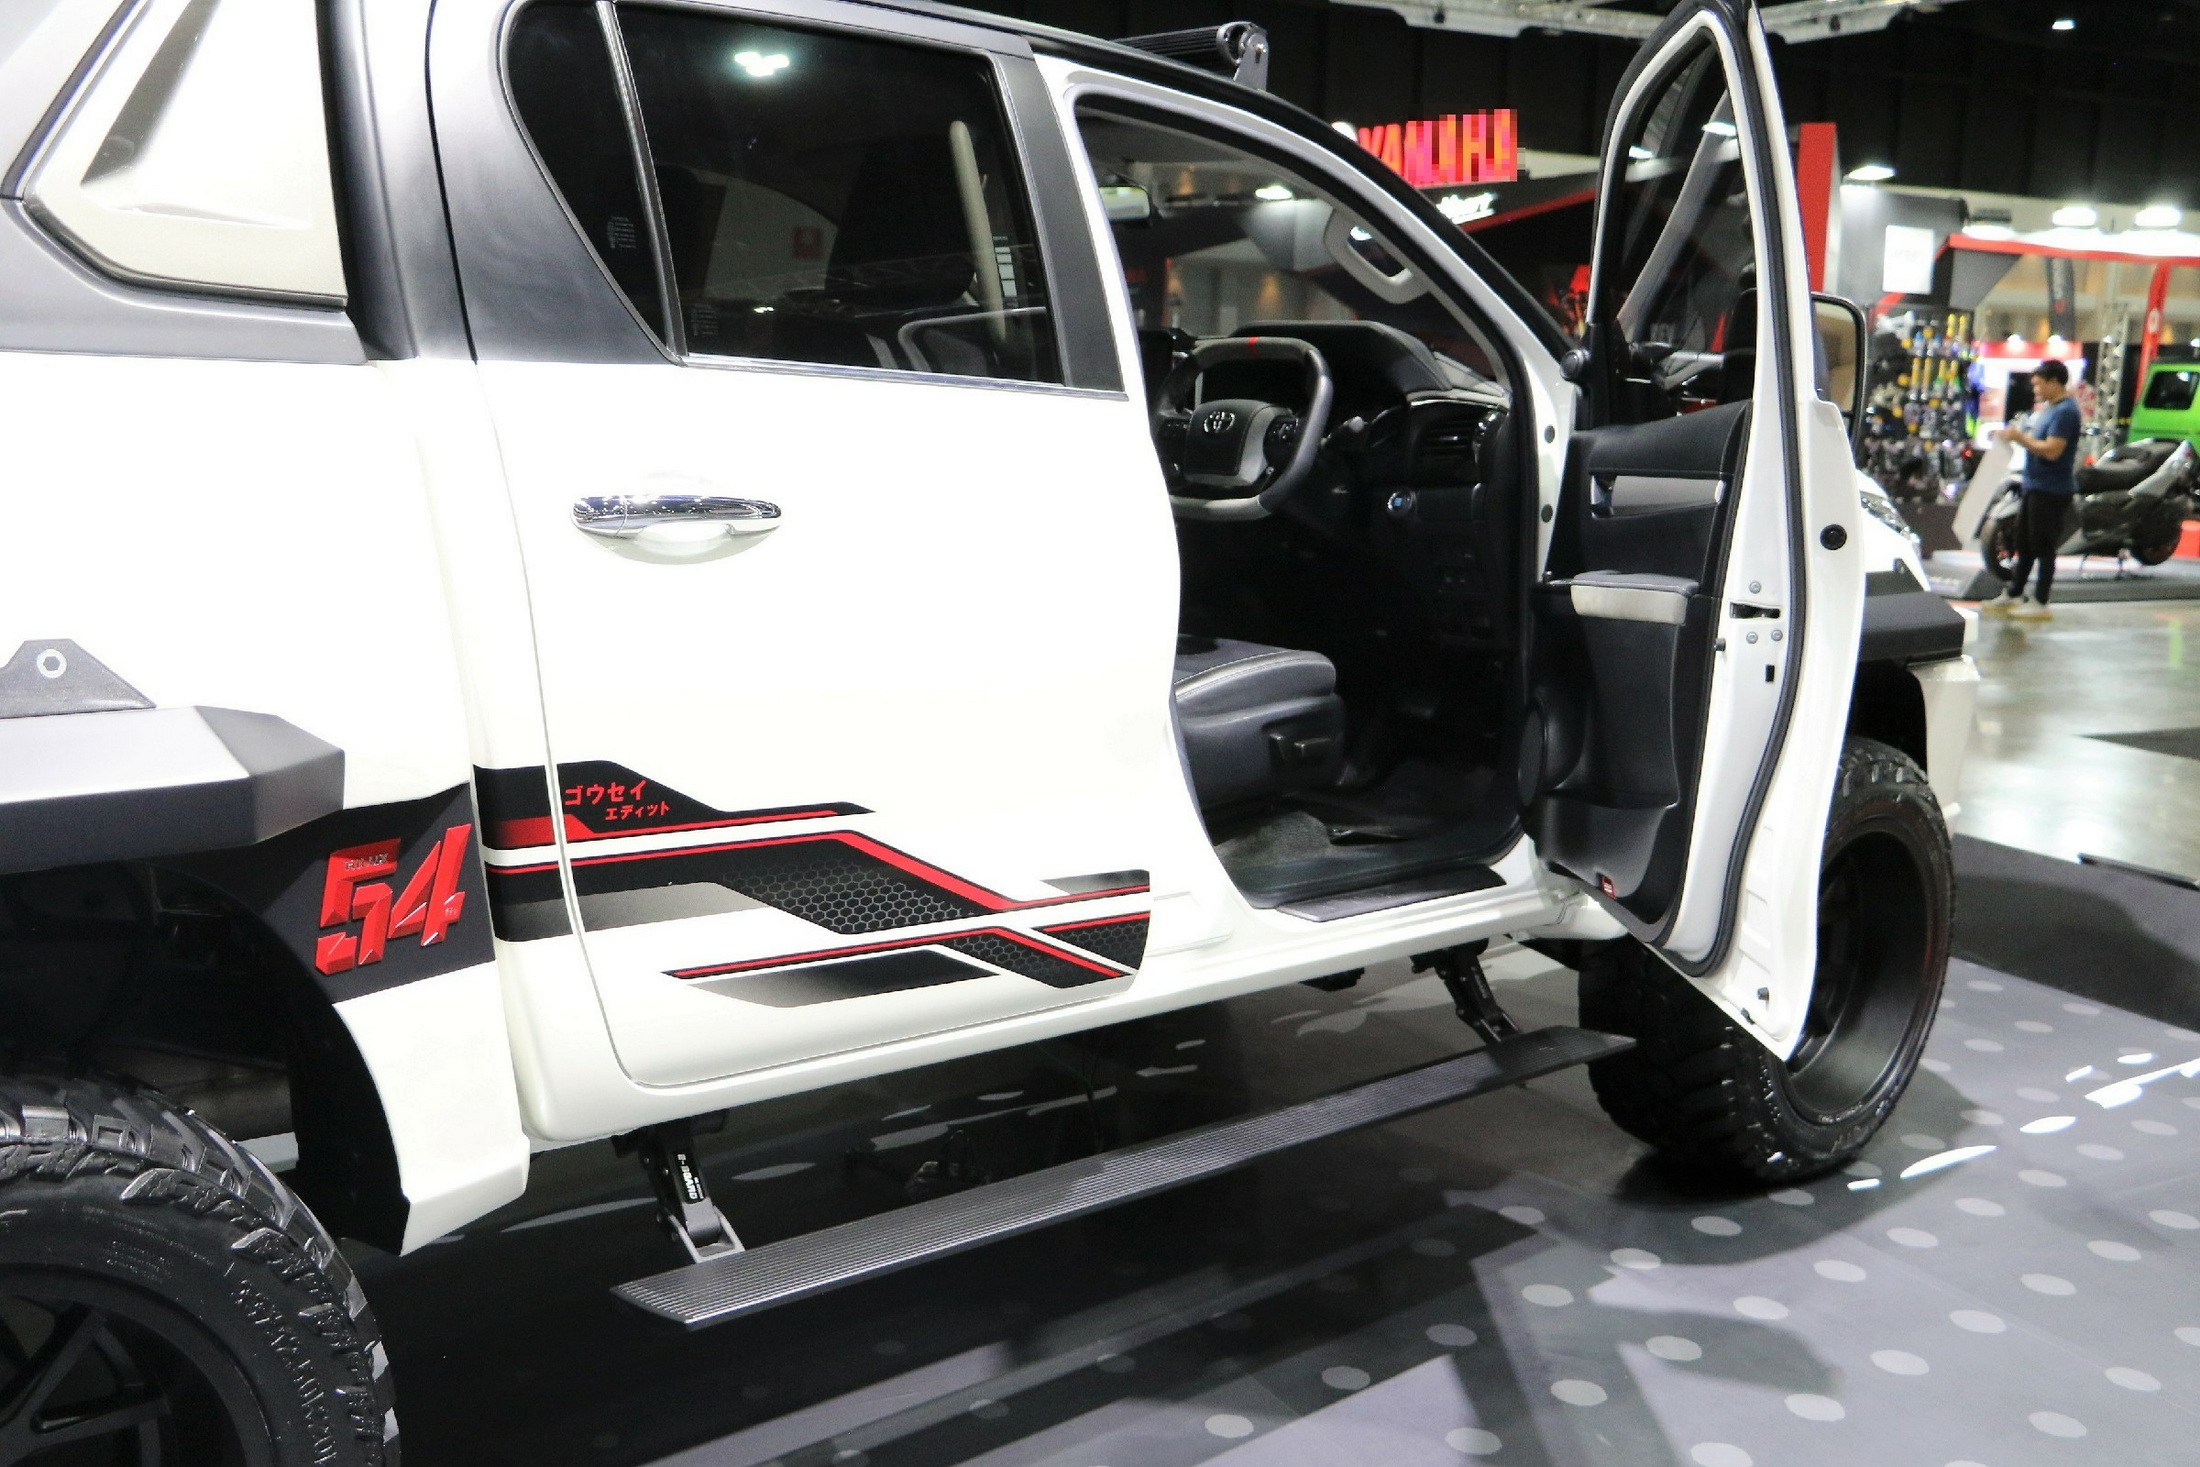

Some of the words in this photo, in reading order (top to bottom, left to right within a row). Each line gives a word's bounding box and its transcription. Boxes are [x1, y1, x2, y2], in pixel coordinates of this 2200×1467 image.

[564, 779, 648, 806] ゴウセイ
[604, 800, 671, 821] エディット
[315, 823, 472, 976] 54
